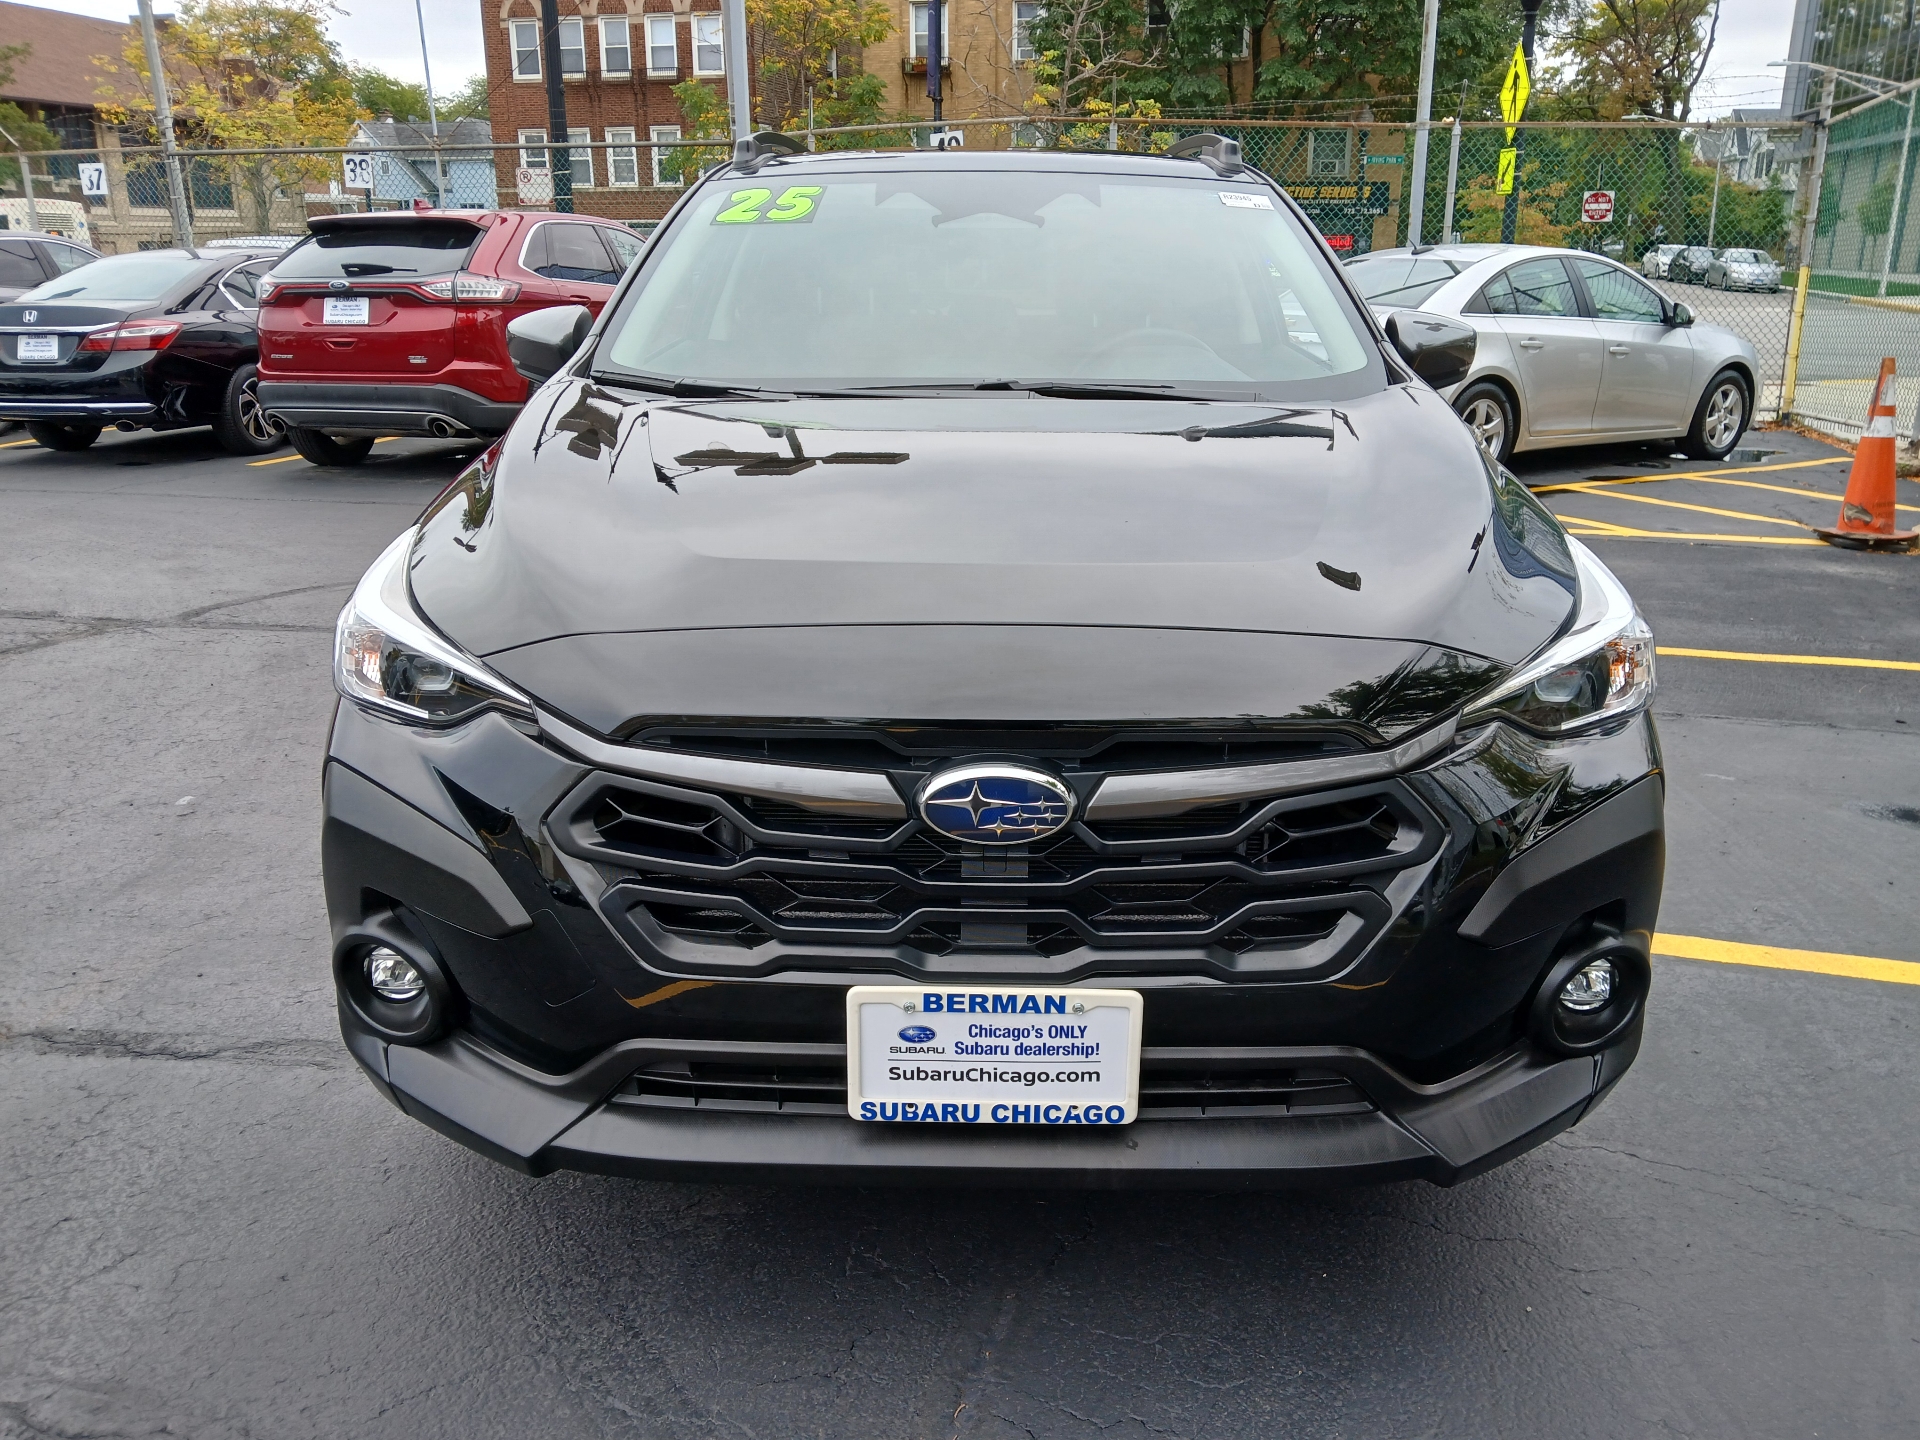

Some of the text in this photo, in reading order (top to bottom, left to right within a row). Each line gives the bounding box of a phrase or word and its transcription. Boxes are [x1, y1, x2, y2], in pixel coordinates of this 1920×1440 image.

[82, 168, 102, 191] 37
[346, 158, 371, 184] 38
[1320, 186, 1372, 198] SERVICS
[715, 186, 823, 223] 25
[922, 992, 1067, 1015] BERMAN
[968, 1024, 1088, 1042] Chicago's ONLY
[889, 1046, 946, 1054] SUBARU
[954, 1041, 1100, 1059] Subaru dealership!
[888, 1066, 1101, 1087] SubaruChicago.com
[860, 1101, 1126, 1124] SUBARU CHICAGO
